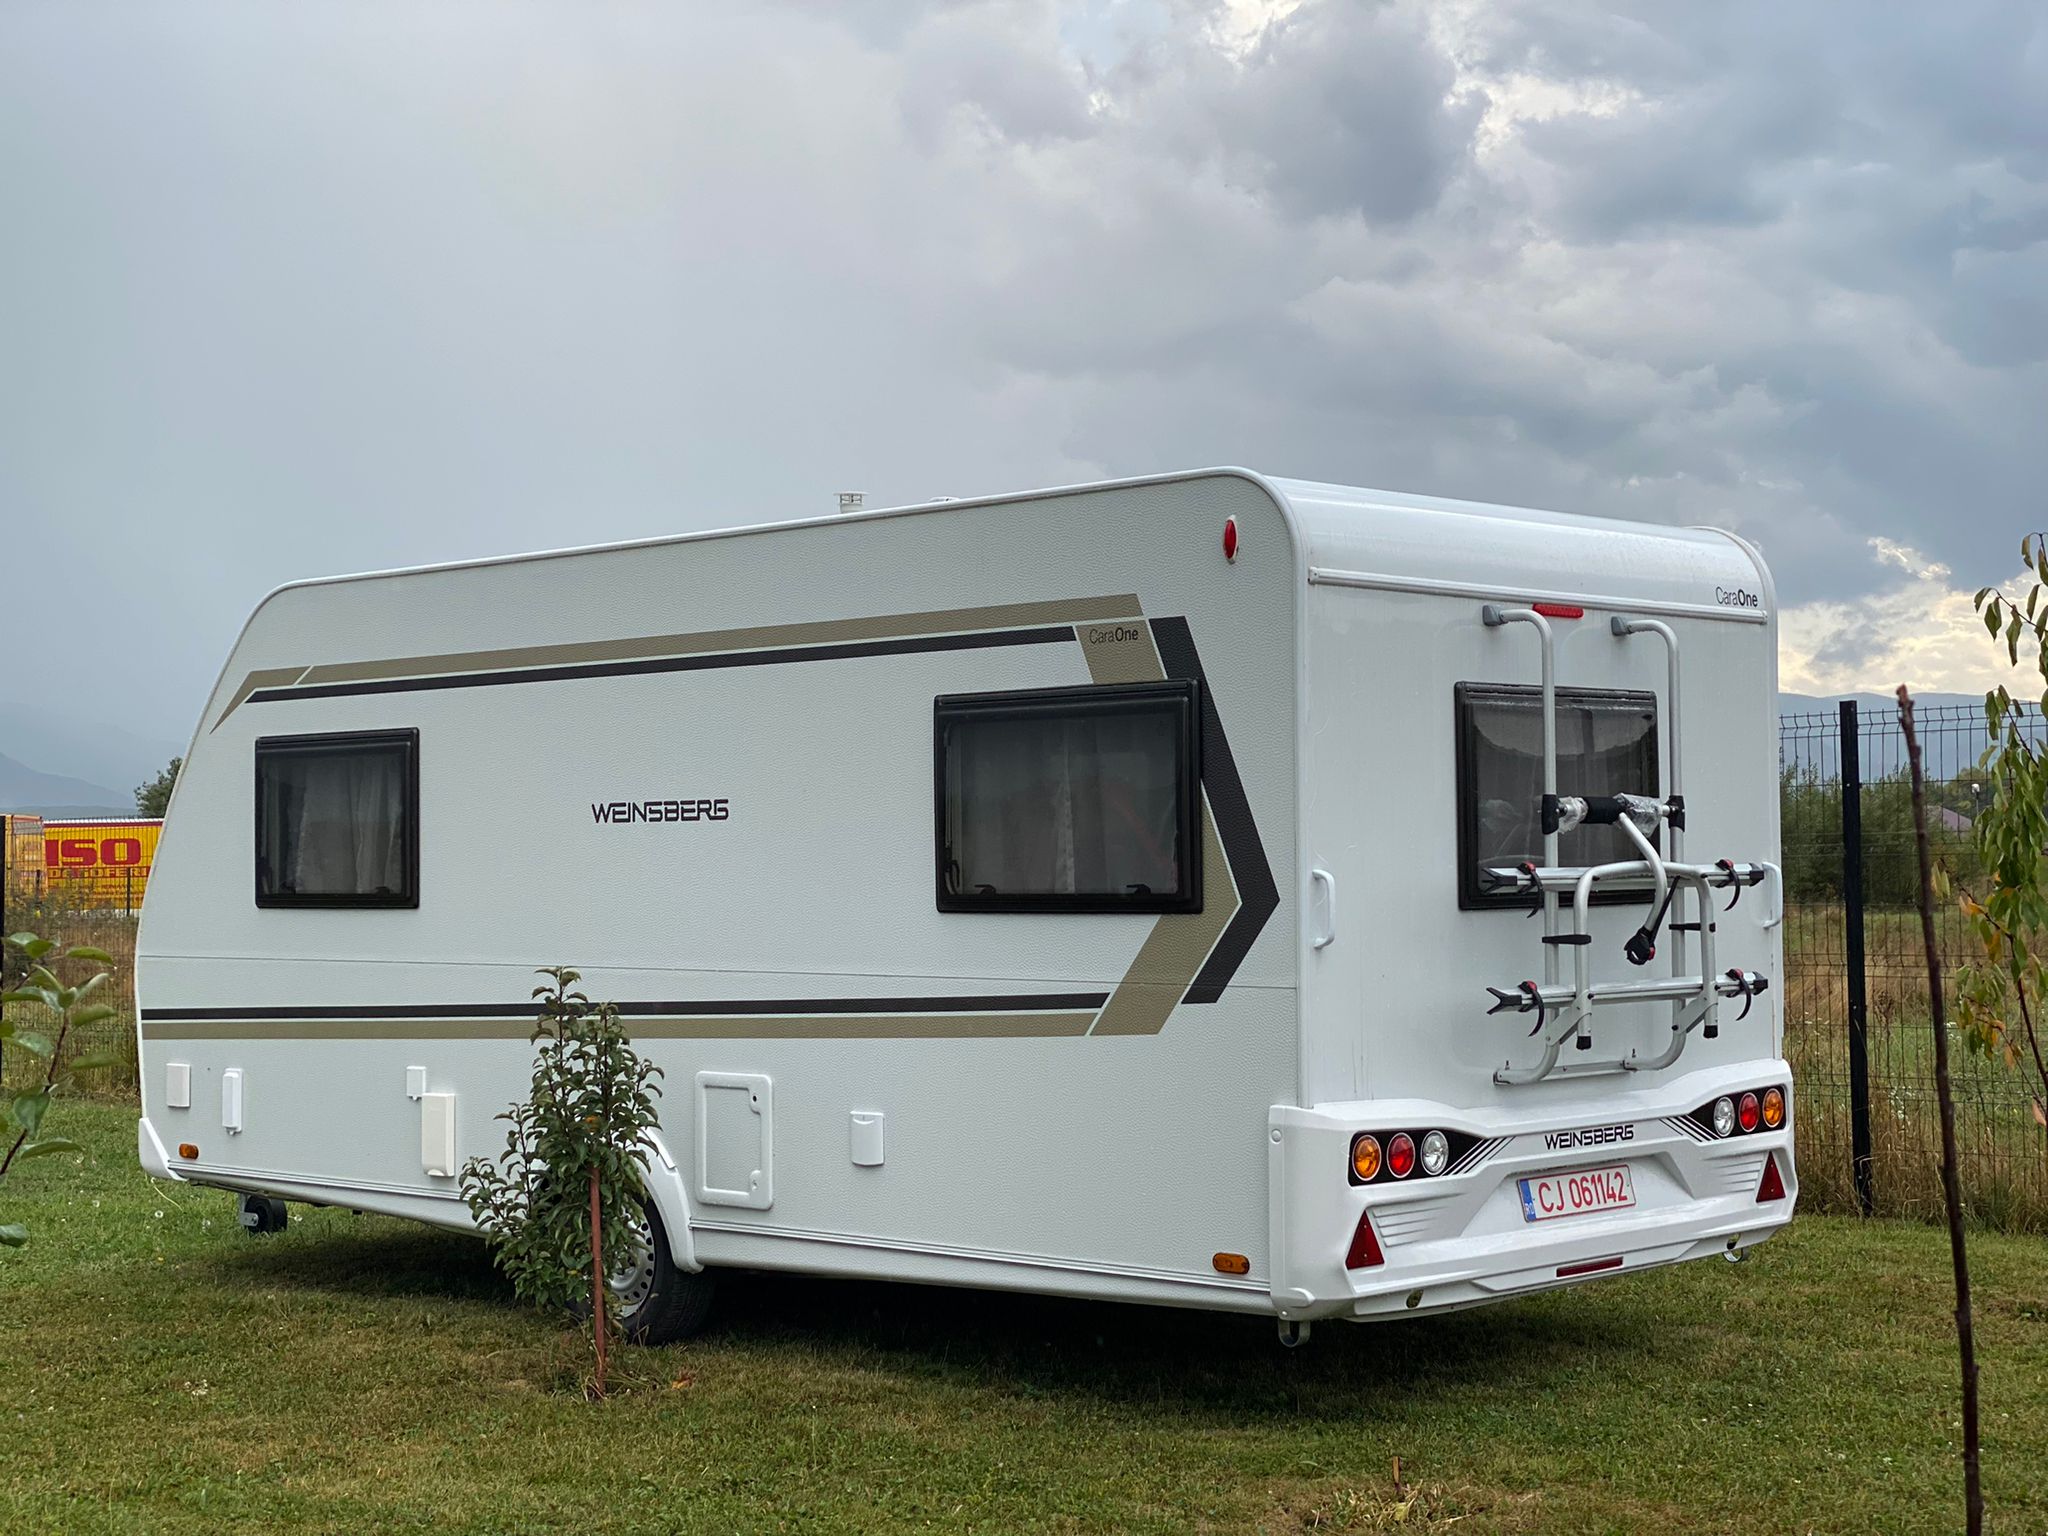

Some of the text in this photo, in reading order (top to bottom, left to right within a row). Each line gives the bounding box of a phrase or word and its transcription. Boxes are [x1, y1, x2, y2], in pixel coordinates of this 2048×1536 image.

[1716, 586, 1758, 607] CaraOne
[1089, 627, 1139, 644] CaraOne
[591, 799, 729, 823] WEINSBERG
[1544, 1124, 1634, 1150] WEINSBERG
[1538, 1171, 1628, 1213] CJ 061142
